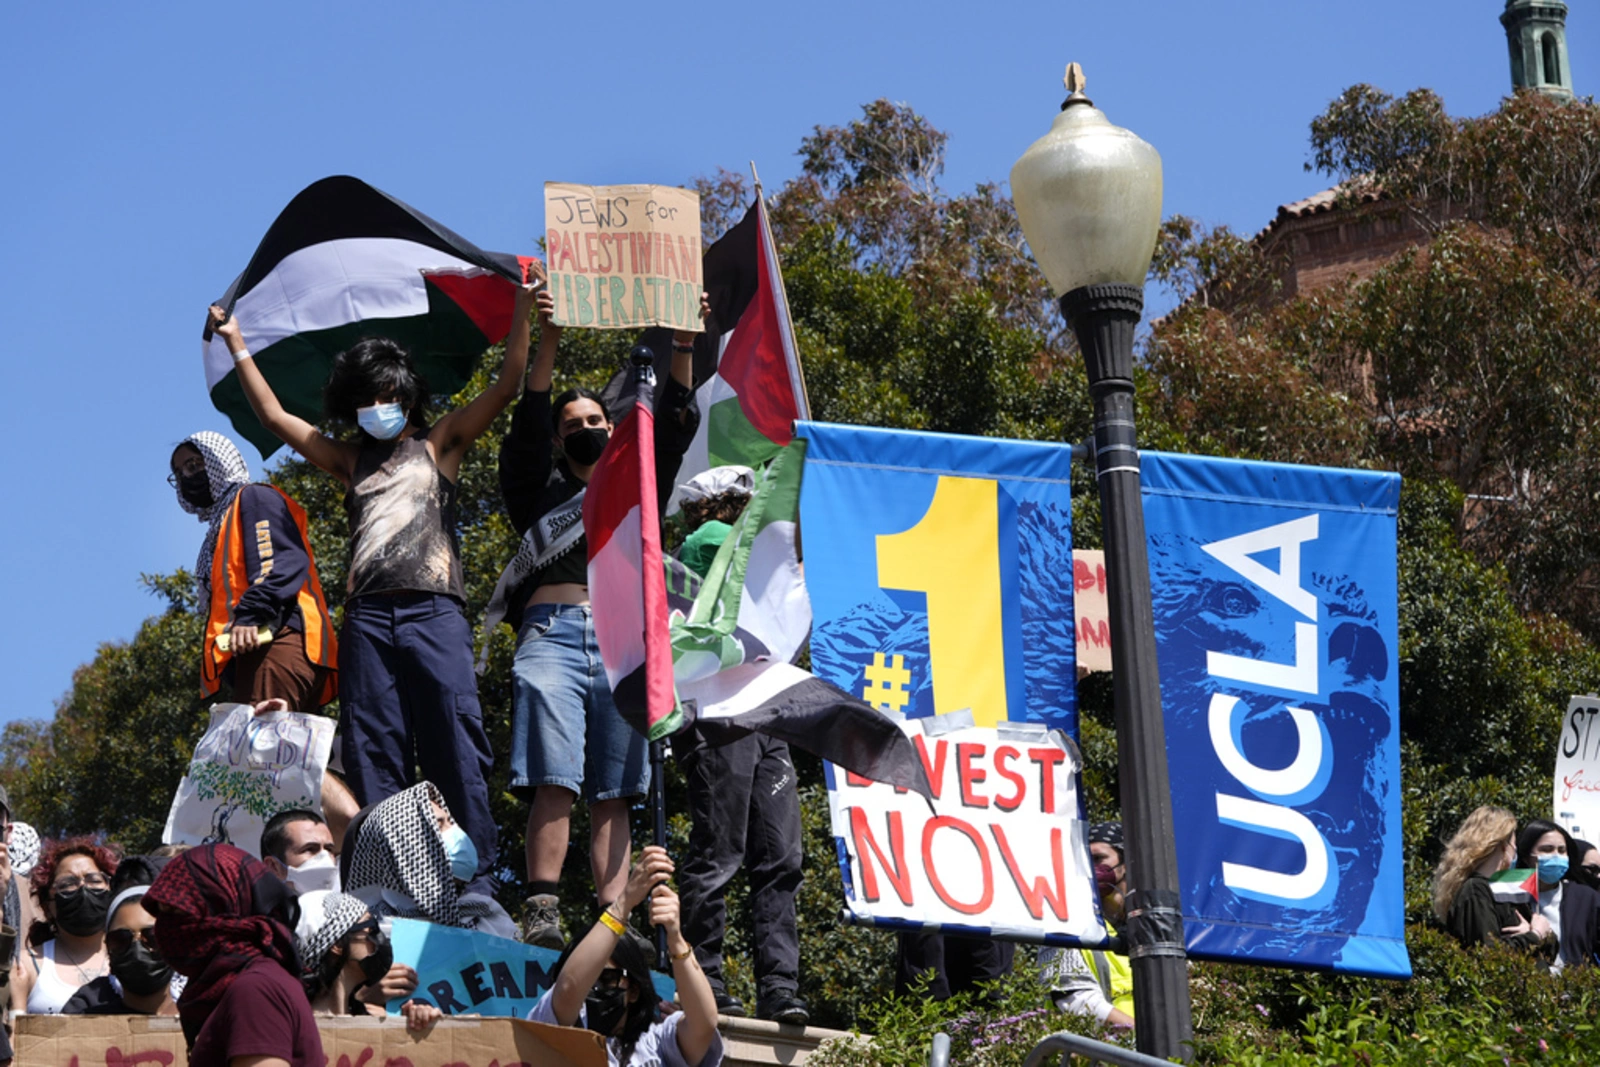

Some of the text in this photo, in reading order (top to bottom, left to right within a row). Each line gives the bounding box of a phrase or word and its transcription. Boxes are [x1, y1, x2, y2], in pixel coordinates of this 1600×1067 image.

[549, 196, 678, 228] JEWS for
[546, 228, 697, 283] PALESTINIAN
[550, 272, 704, 330] LIBERATION
[1199, 512, 1329, 900] UCLA
[1563, 706, 1600, 760] ST
[847, 733, 1067, 815] VEST
[849, 805, 1069, 922] NOW
[400, 960, 557, 1015] REAM
